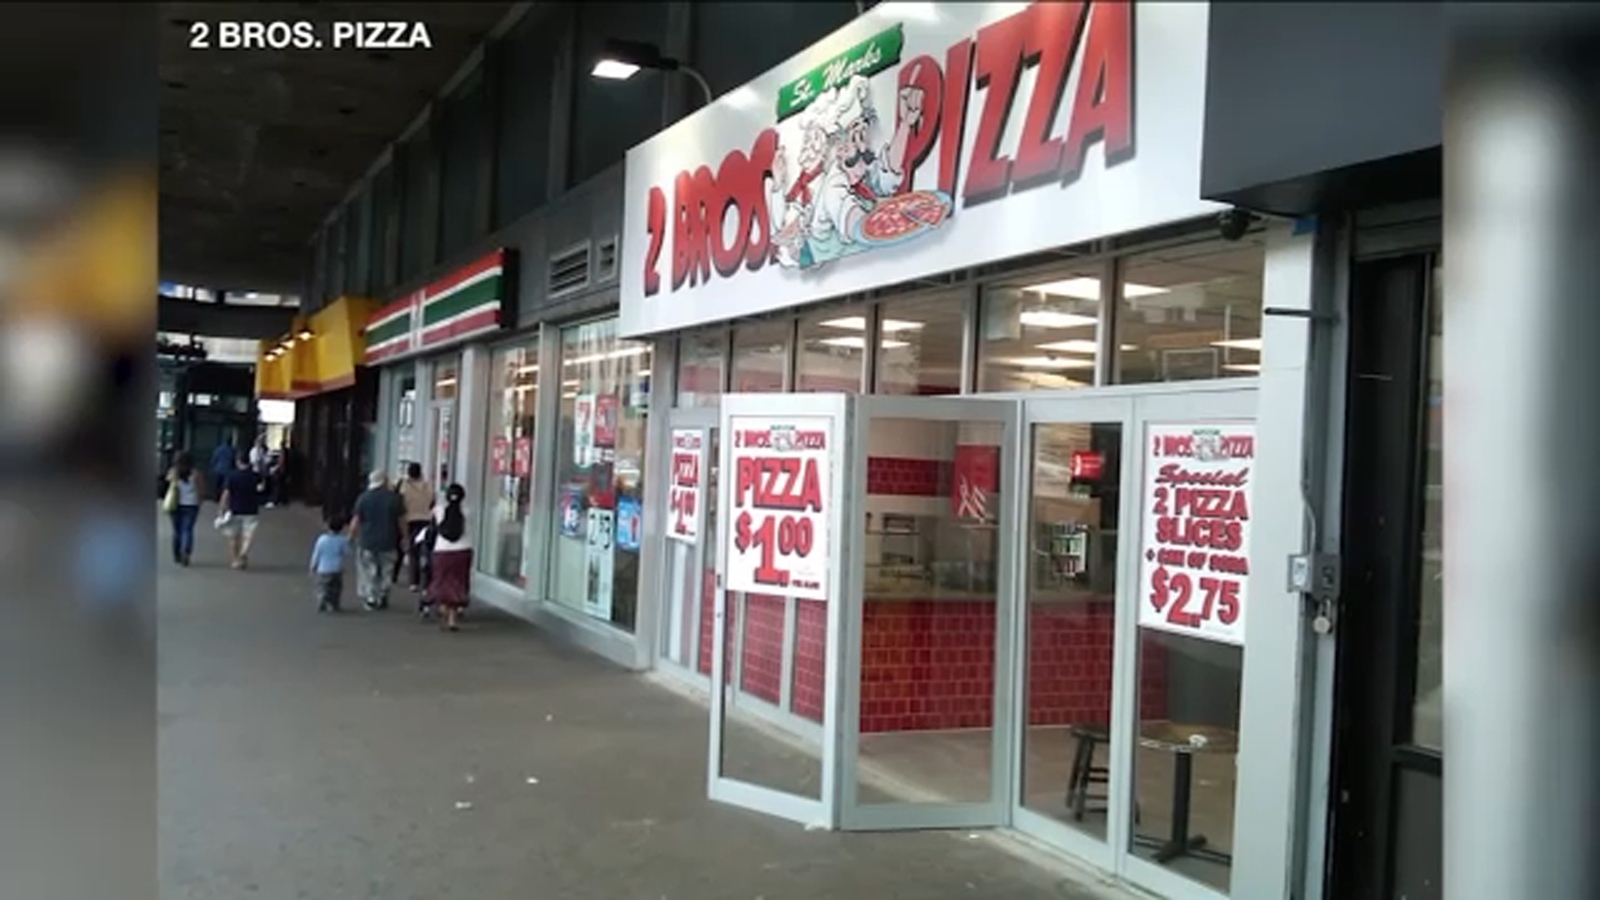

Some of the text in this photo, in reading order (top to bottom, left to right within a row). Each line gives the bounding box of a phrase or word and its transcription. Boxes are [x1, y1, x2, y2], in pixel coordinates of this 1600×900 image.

[823, 42, 881, 90] Marks
[644, 186, 667, 298] 2
[897, 0, 1137, 218] PIZZA
[735, 456, 822, 513] PIZZA
[1154, 463, 1249, 488] Special
[1152, 486, 1248, 521] 2 PIZZA
[1156, 517, 1242, 551] SLICES
[1150, 566, 1240, 628] $2.75
